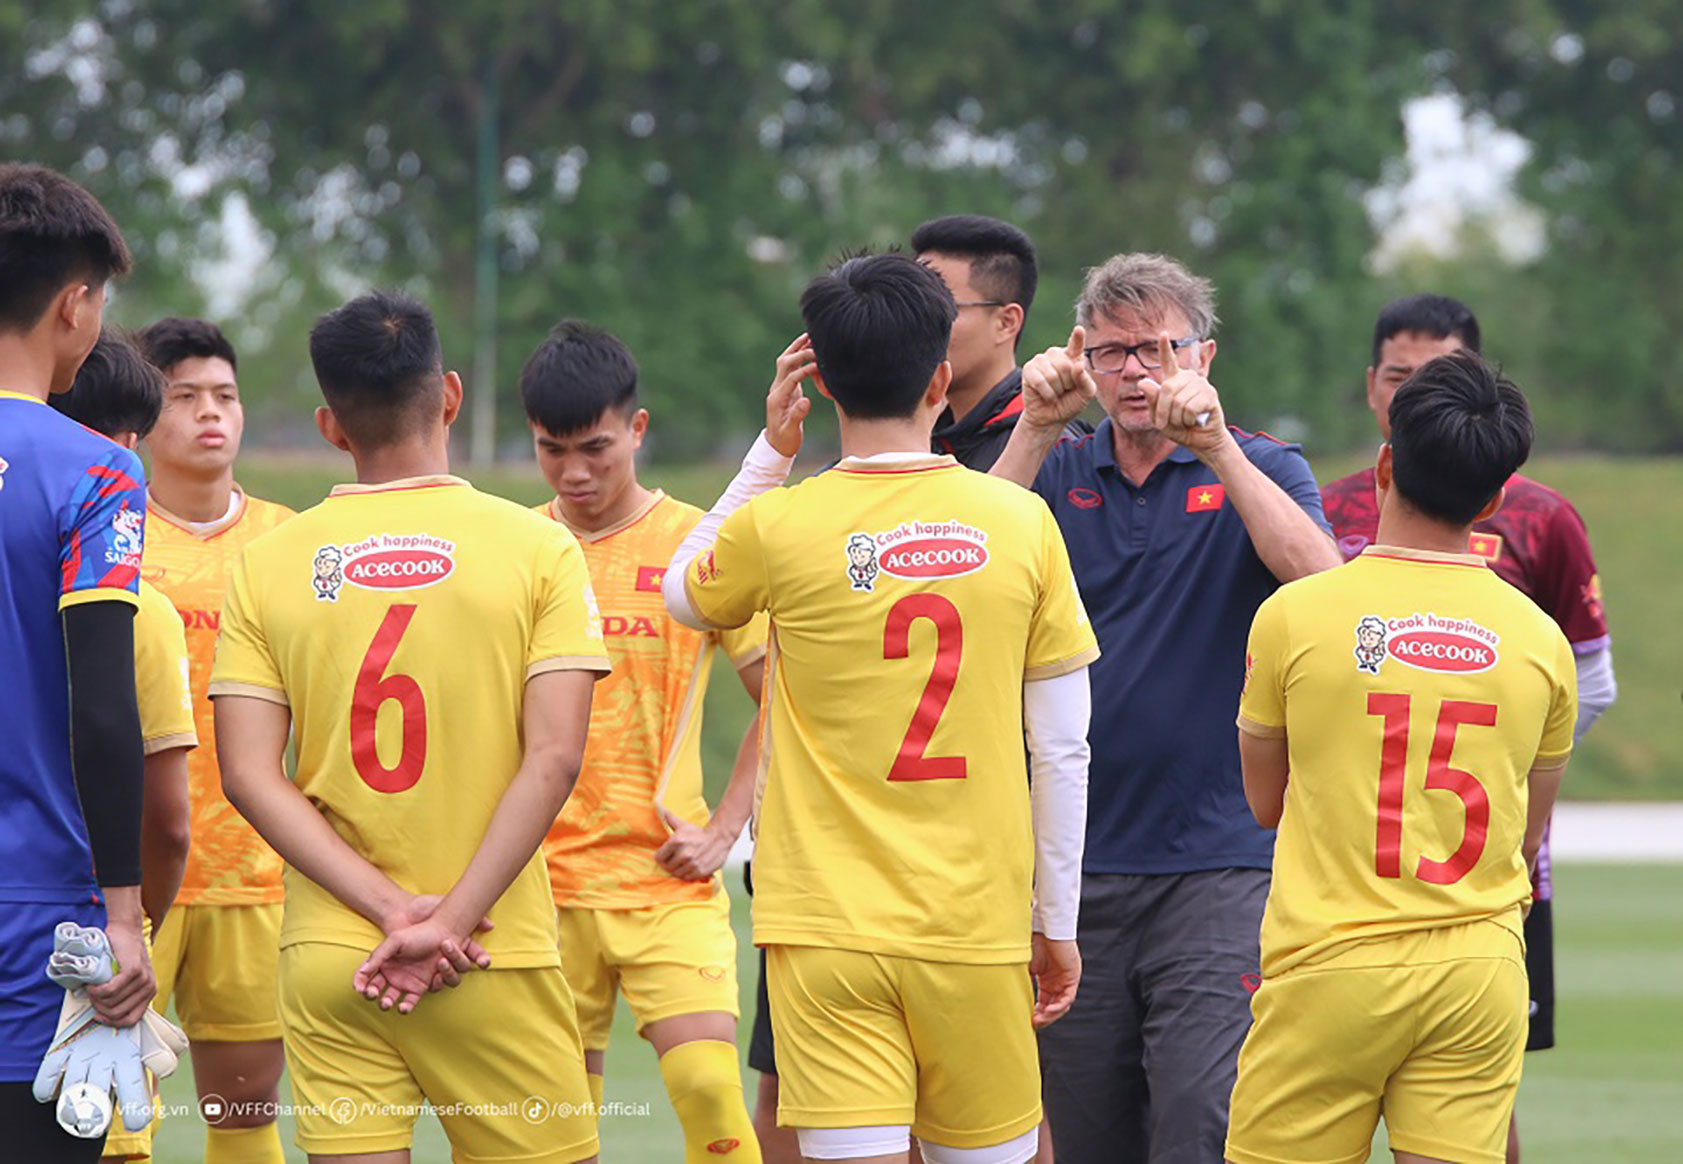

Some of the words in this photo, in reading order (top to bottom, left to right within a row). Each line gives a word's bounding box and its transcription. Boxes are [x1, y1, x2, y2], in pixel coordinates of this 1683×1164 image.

[343, 537, 379, 557] Cook
[383, 534, 453, 551] happiness
[877, 525, 911, 546] Cook
[915, 521, 985, 541] happiness
[601, 616, 659, 637] DA
[1388, 615, 1424, 632] Cook
[1428, 614, 1498, 645] happiness
[350, 603, 427, 793] 6
[883, 592, 967, 781] 2
[1367, 692, 1498, 885] 15
